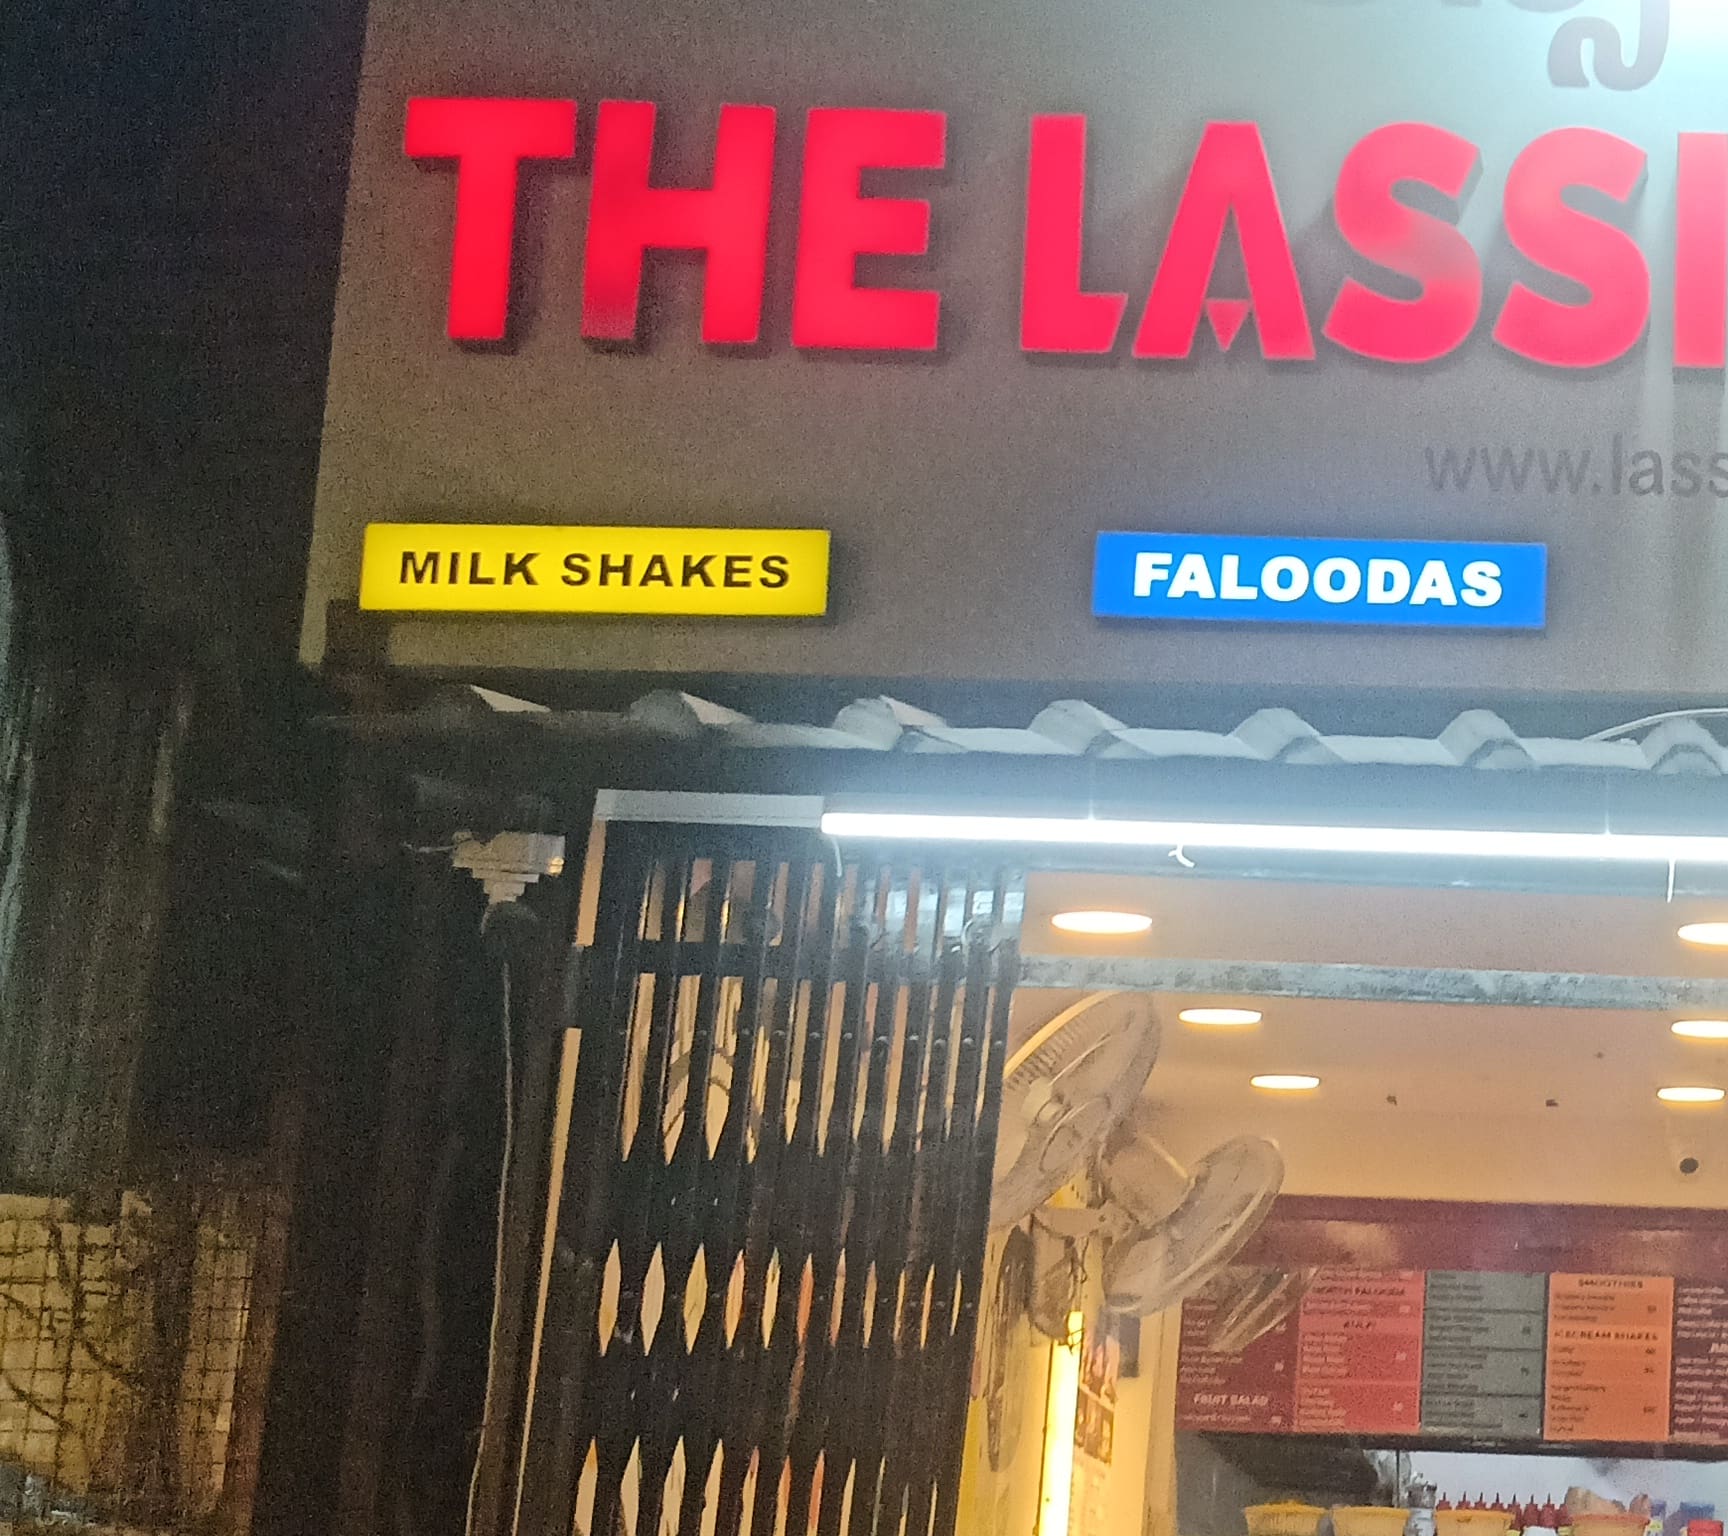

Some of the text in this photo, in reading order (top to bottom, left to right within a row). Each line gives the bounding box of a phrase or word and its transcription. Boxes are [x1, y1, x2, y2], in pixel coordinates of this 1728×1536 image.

[404, 97, 948, 352] THE
[397, 549, 793, 593] MILK SHAKES
[1132, 550, 1505, 611] FALOODAS
